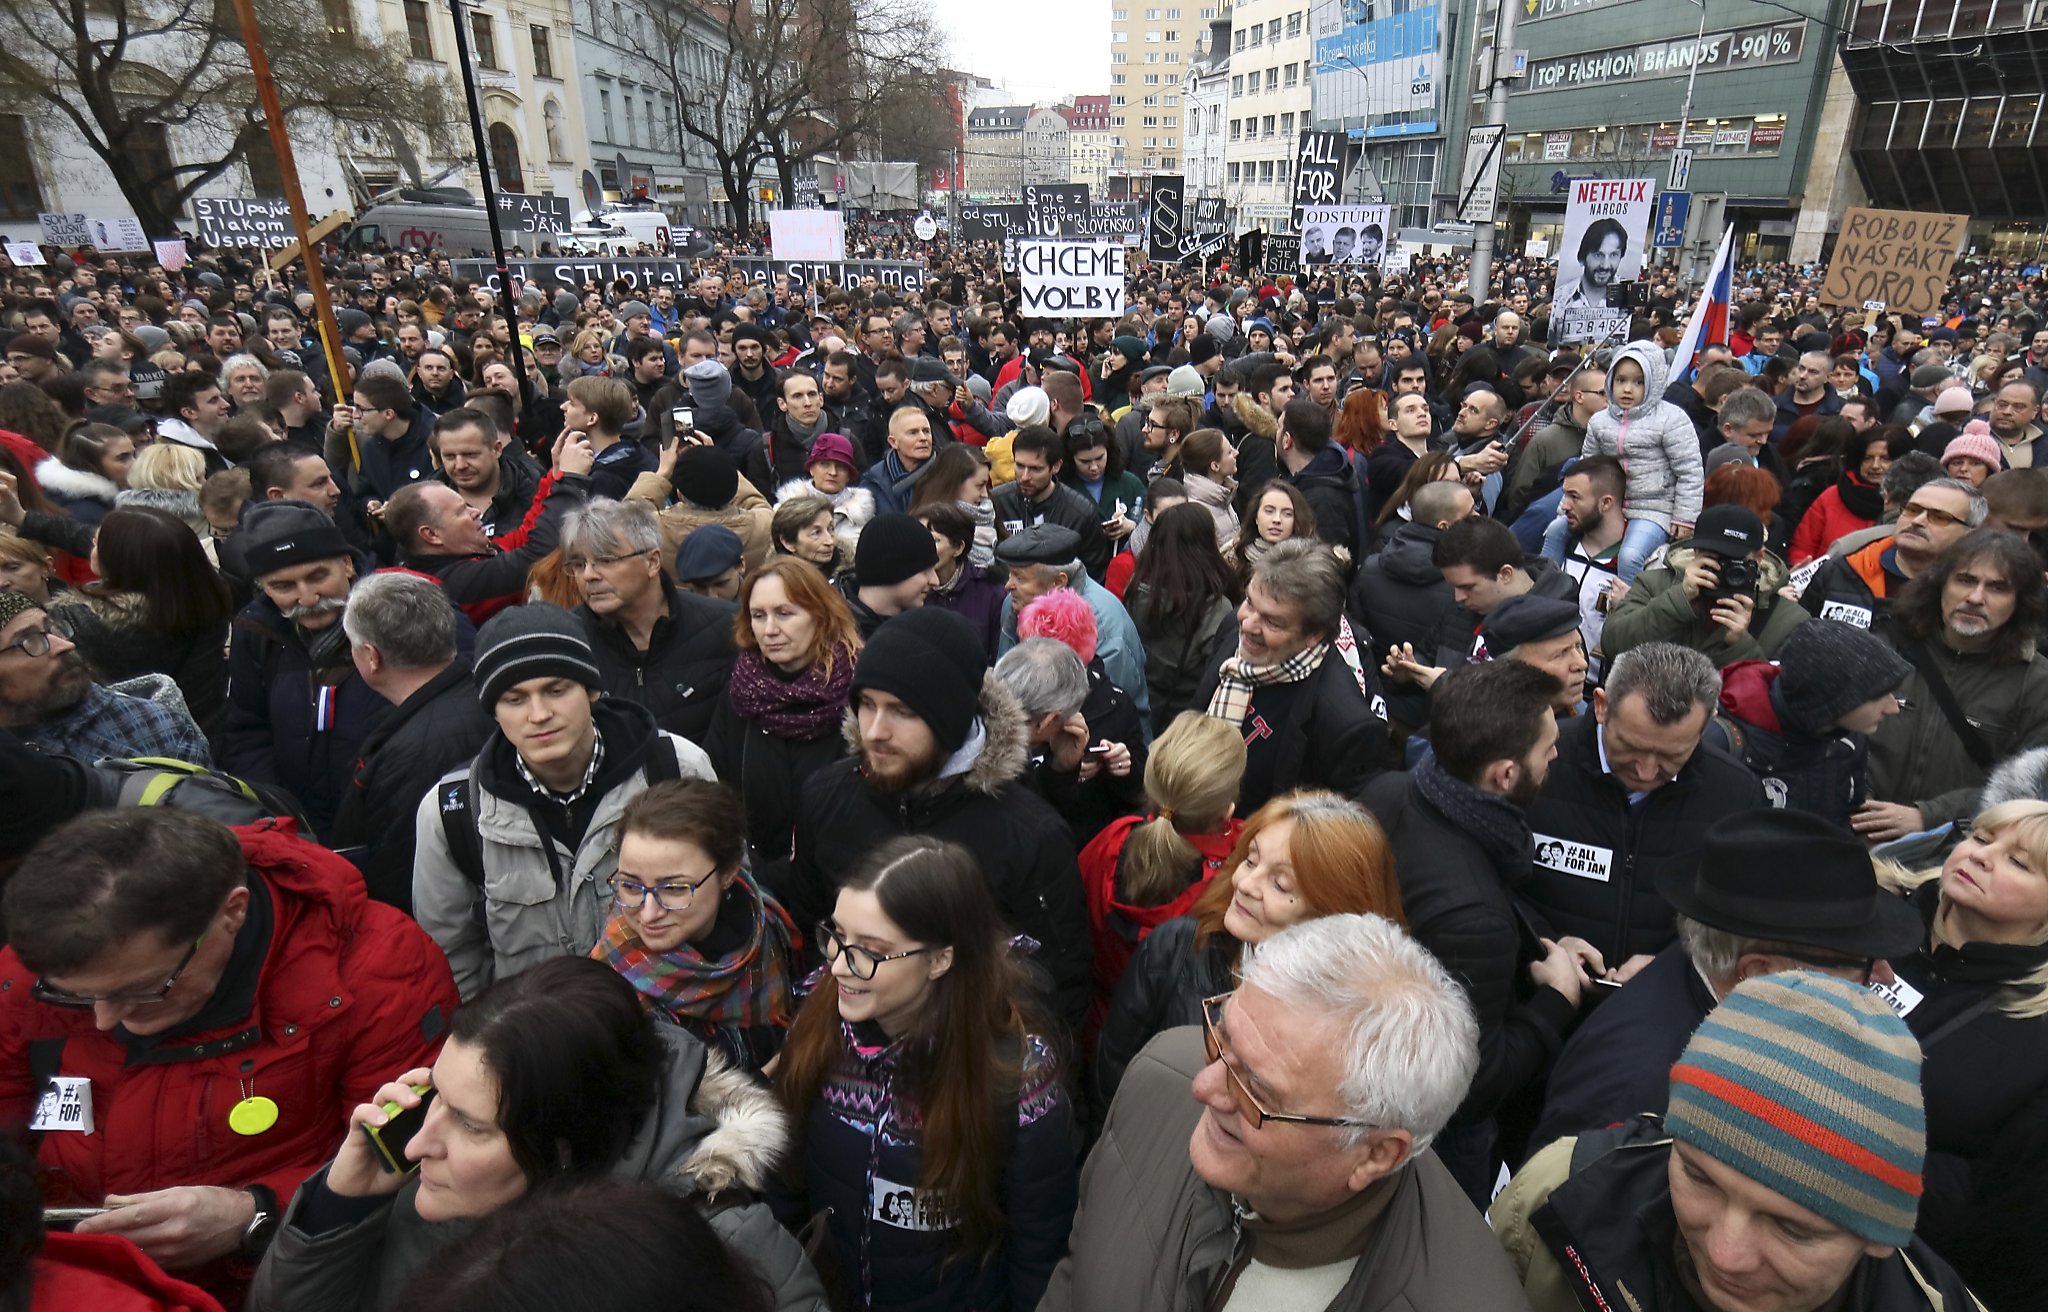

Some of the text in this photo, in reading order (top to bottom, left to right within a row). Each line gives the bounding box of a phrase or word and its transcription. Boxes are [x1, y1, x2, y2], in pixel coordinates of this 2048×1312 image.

[1352, 37, 1376, 57] všetko
[1538, 64, 1565, 86] TOP
[1568, 55, 1636, 82] FASHION
[1643, 41, 1720, 72] BRANDS
[1470, 132, 1485, 144] PEŠIA
[1301, 135, 1339, 170] ALL
[1297, 170, 1336, 205] FOR
[1577, 181, 1647, 204] NETFLIX
[520, 199, 562, 215] ALL
[962, 207, 980, 220] od
[1306, 207, 1386, 224] ODSTÚPIŤ
[1589, 203, 1629, 216] NARCOS
[200, 216, 284, 232] Tlakom
[523, 219, 564, 234] JAN
[1077, 219, 1134, 235] SLOVENSKO
[1848, 213, 1956, 246] ROBO UŽ
[203, 231, 299, 249] Uspejem
[1177, 233, 1203, 255] CEZ
[1269, 238, 1300, 250] POKOJ
[1277, 250, 1291, 258] JE
[1840, 238, 1889, 266] NÁS
[1022, 245, 1124, 277] CHCEME
[1269, 257, 1297, 272] SILA
[1022, 284, 1121, 311] VOĽBY
[1827, 265, 1942, 314] SOROS
[1565, 320, 1628, 335] 128482
[1843, 615, 1871, 628] FOR JAN
[1845, 608, 1865, 618] #ALL
[1567, 845, 1596, 862] #ALL
[1564, 857, 1606, 876] FOR JAN
[59, 1103, 81, 1122] FOR
